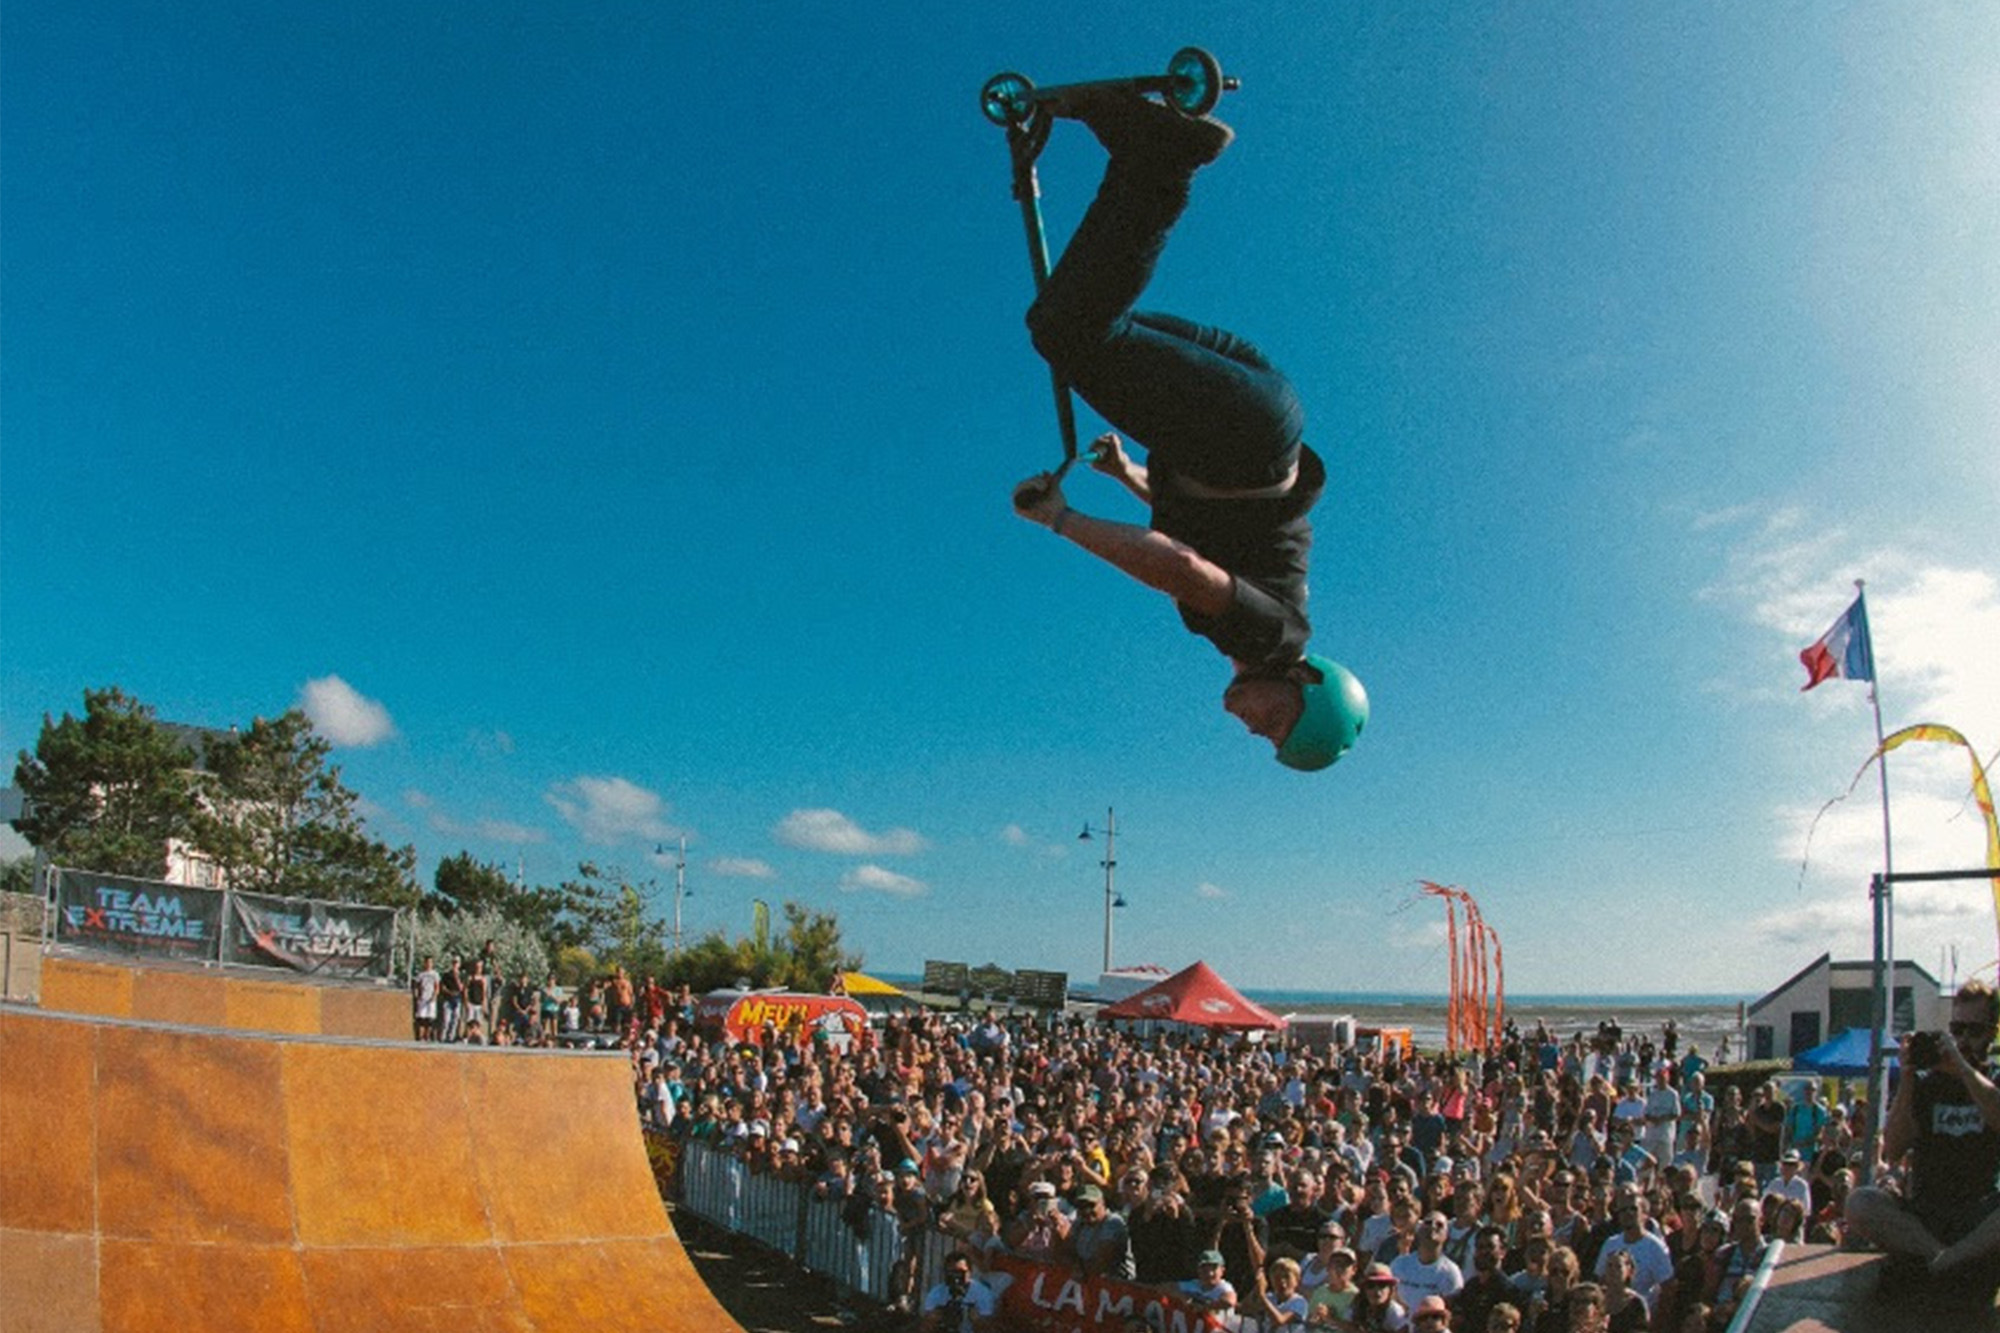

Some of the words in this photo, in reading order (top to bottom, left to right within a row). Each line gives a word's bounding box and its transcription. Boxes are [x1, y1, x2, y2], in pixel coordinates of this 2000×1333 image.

[96, 887, 182, 917] TEAM
[63, 905, 204, 940] EXTREME
[264, 912, 351, 937] TEAM
[1031, 1272, 1086, 1317] LA
